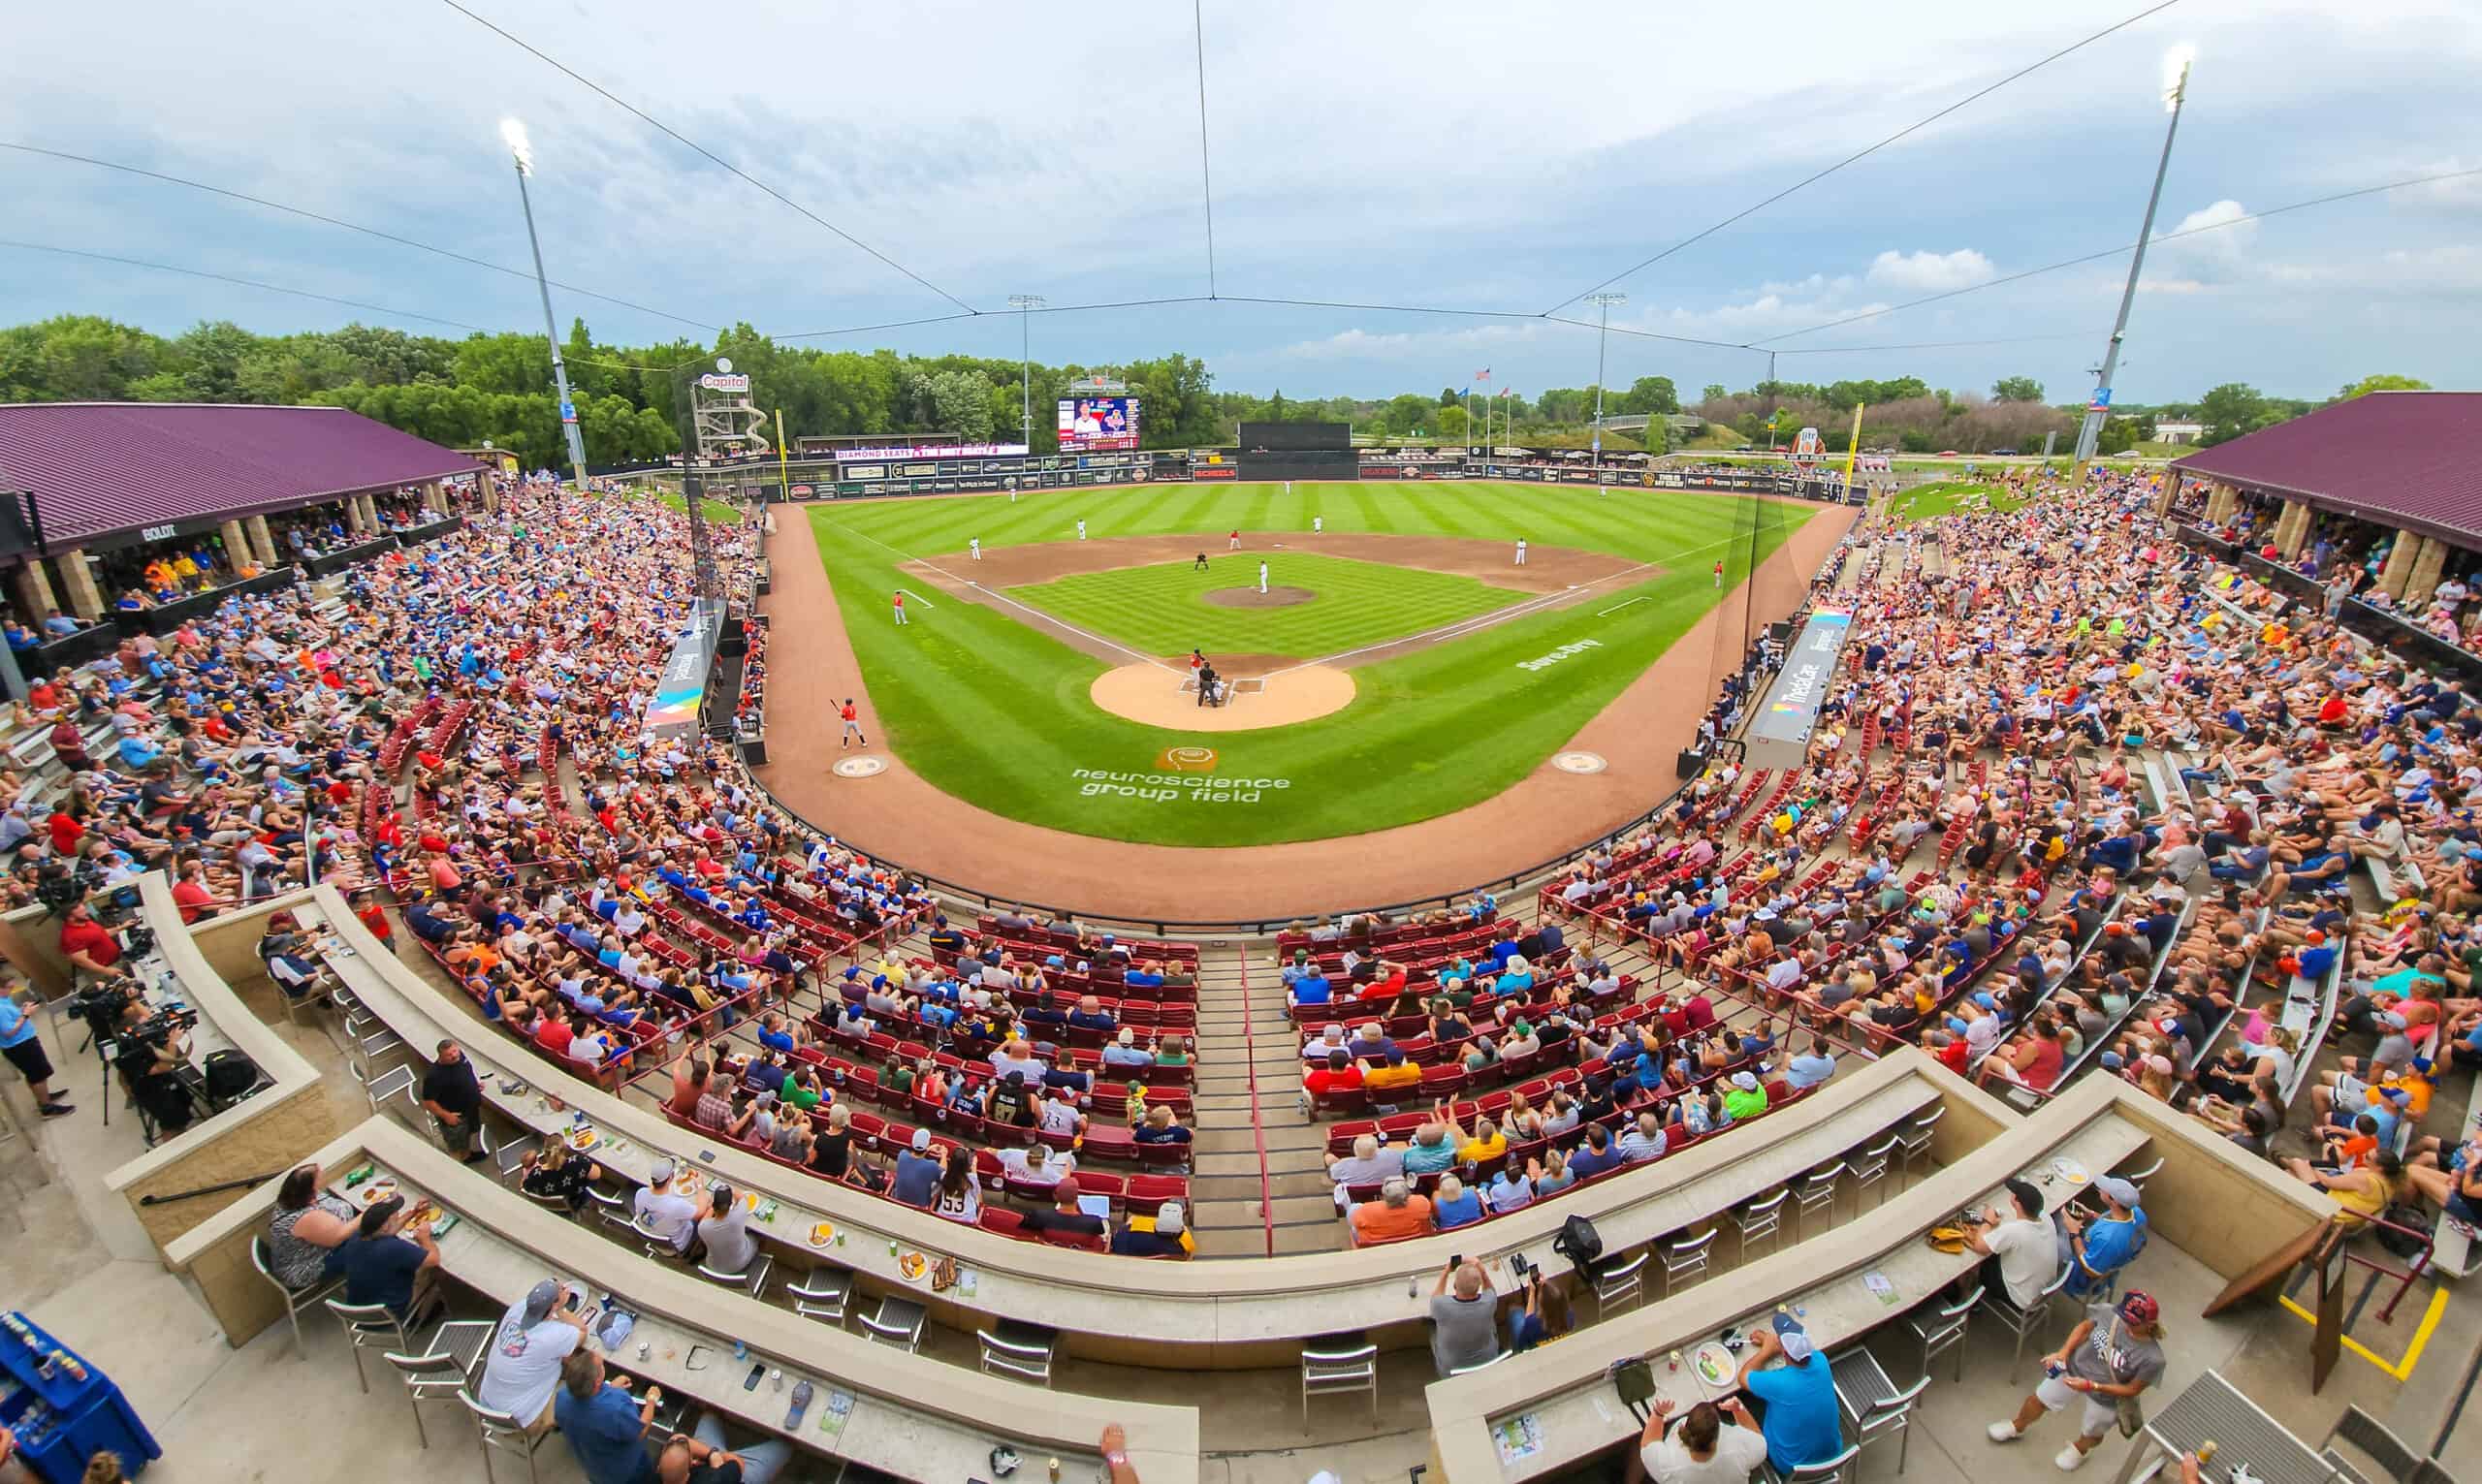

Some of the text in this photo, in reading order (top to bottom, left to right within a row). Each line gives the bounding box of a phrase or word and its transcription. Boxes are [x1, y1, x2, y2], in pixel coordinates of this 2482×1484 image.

[704, 375, 747, 389] Capital
[838, 450, 881, 458] DIAMOND
[142, 523, 175, 541] BOLDT
[1071, 768, 1290, 789] neuroscience
[1080, 783, 1260, 803] group field
